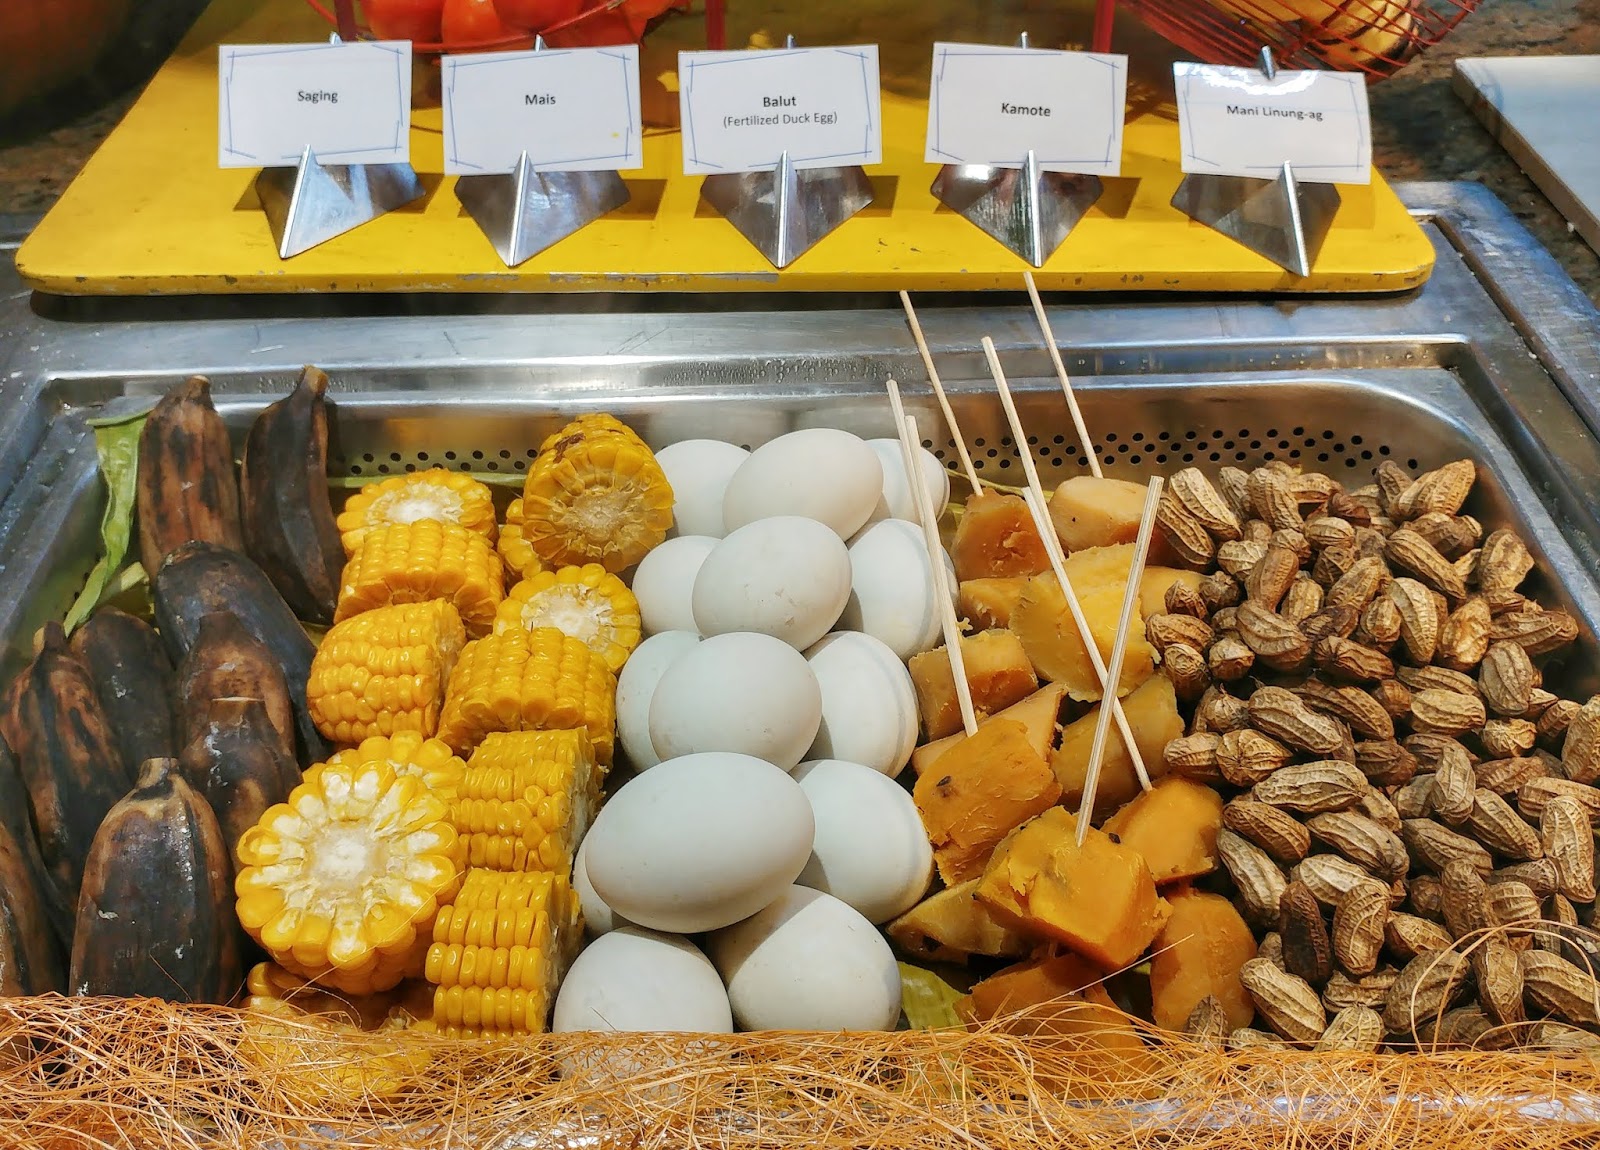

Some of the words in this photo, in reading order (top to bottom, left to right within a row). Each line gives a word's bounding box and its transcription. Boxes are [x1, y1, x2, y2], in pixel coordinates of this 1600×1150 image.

[297, 89, 338, 105] Saging
[525, 93, 557, 105] Mais
[762, 95, 797, 108] Balut
[1001, 102, 1051, 117] Kamote
[1226, 105, 1259, 116] Mani
[1263, 107, 1323, 122] Linung-ag
[722, 114, 780, 128] (Fertilized
[782, 113, 812, 125] Duck
[813, 112, 838, 127] Egg)
